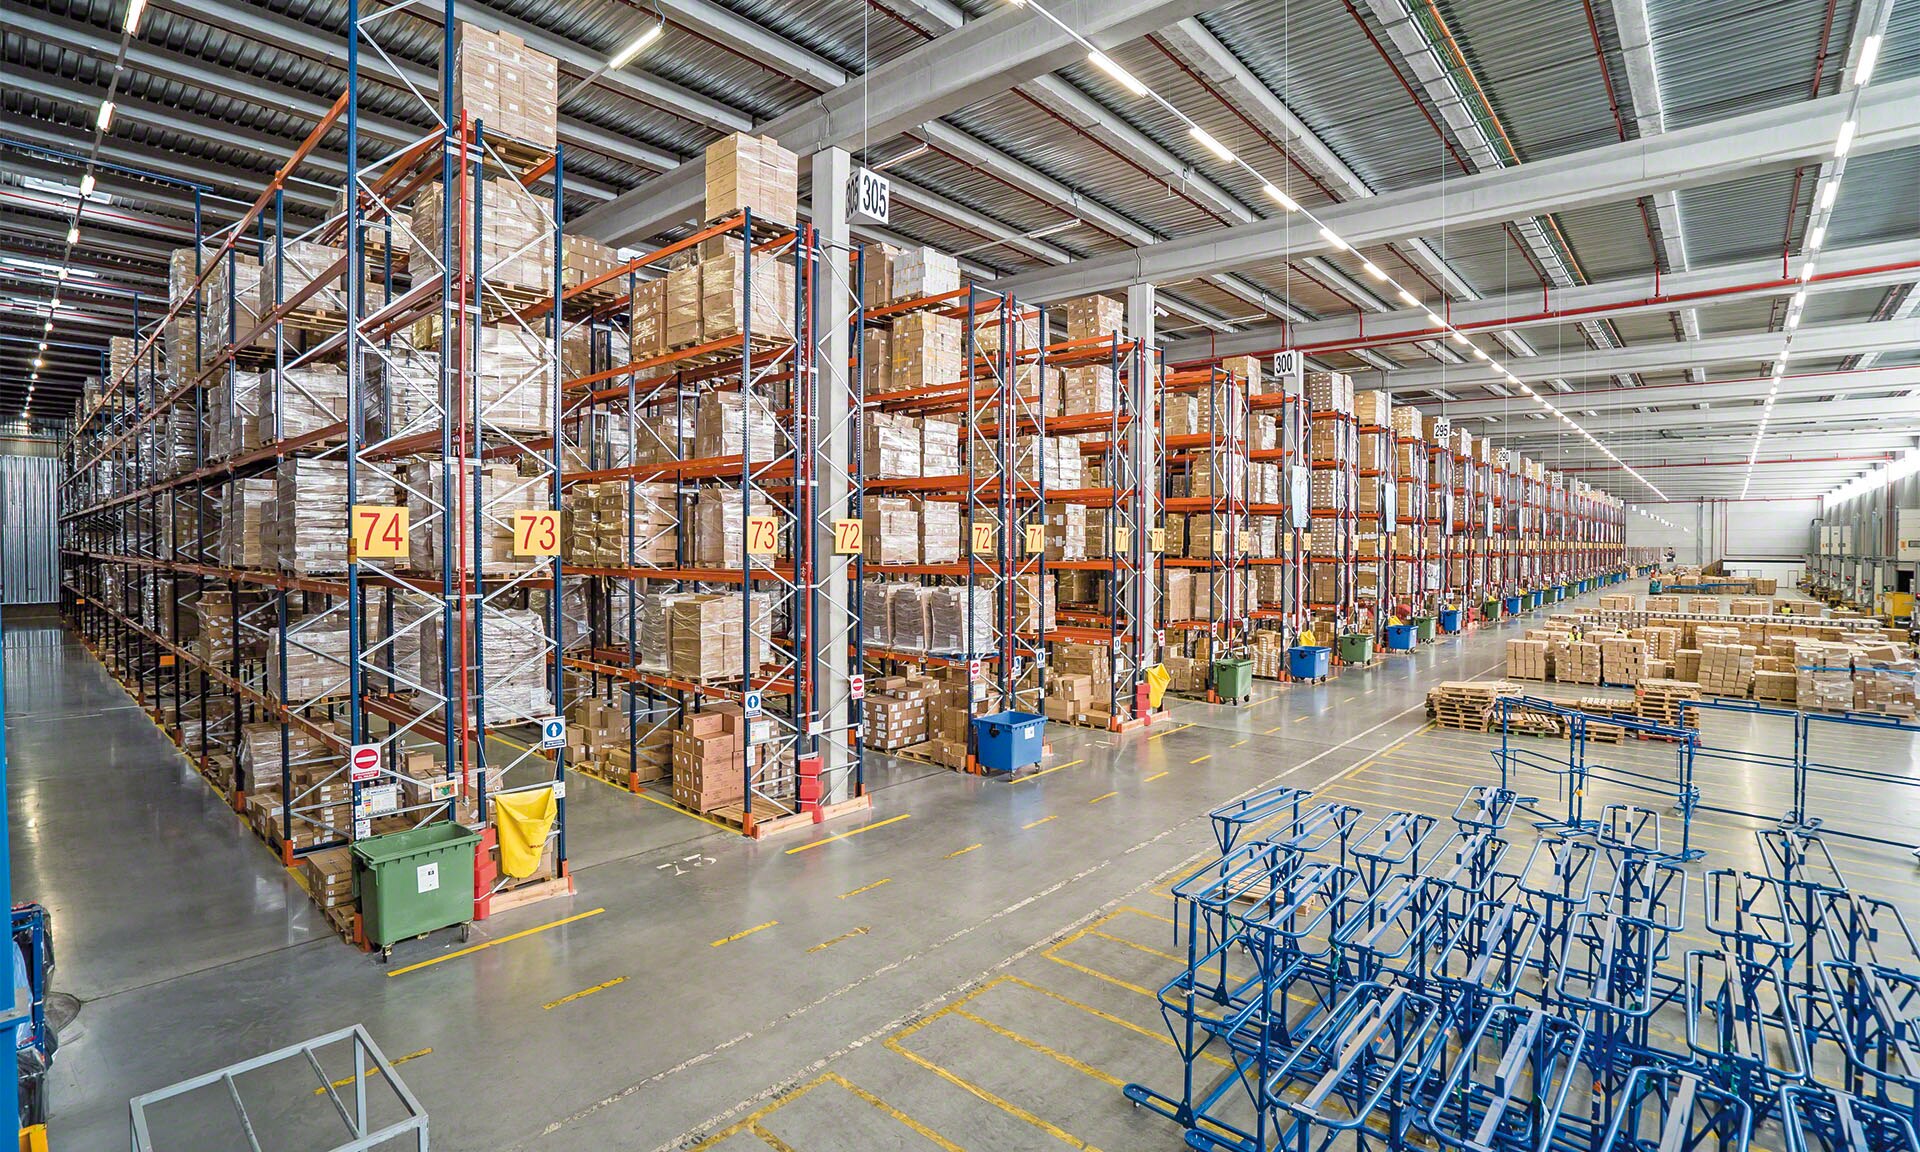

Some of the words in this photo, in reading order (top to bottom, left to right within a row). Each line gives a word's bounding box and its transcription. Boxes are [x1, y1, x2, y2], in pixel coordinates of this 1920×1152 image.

[846, 175, 859, 218] 305
[863, 174, 886, 218] 305
[1276, 353, 1293, 374] 300
[1435, 424, 1448, 437] 295
[360, 512, 403, 551] 74
[520, 515, 556, 550] 73
[751, 521, 775, 549] 73
[839, 523, 860, 549] 72
[975, 527, 990, 549] 72
[1029, 528, 1042, 549] 71
[1118, 530, 1127, 549] 71
[1153, 531, 1164, 549] 70
